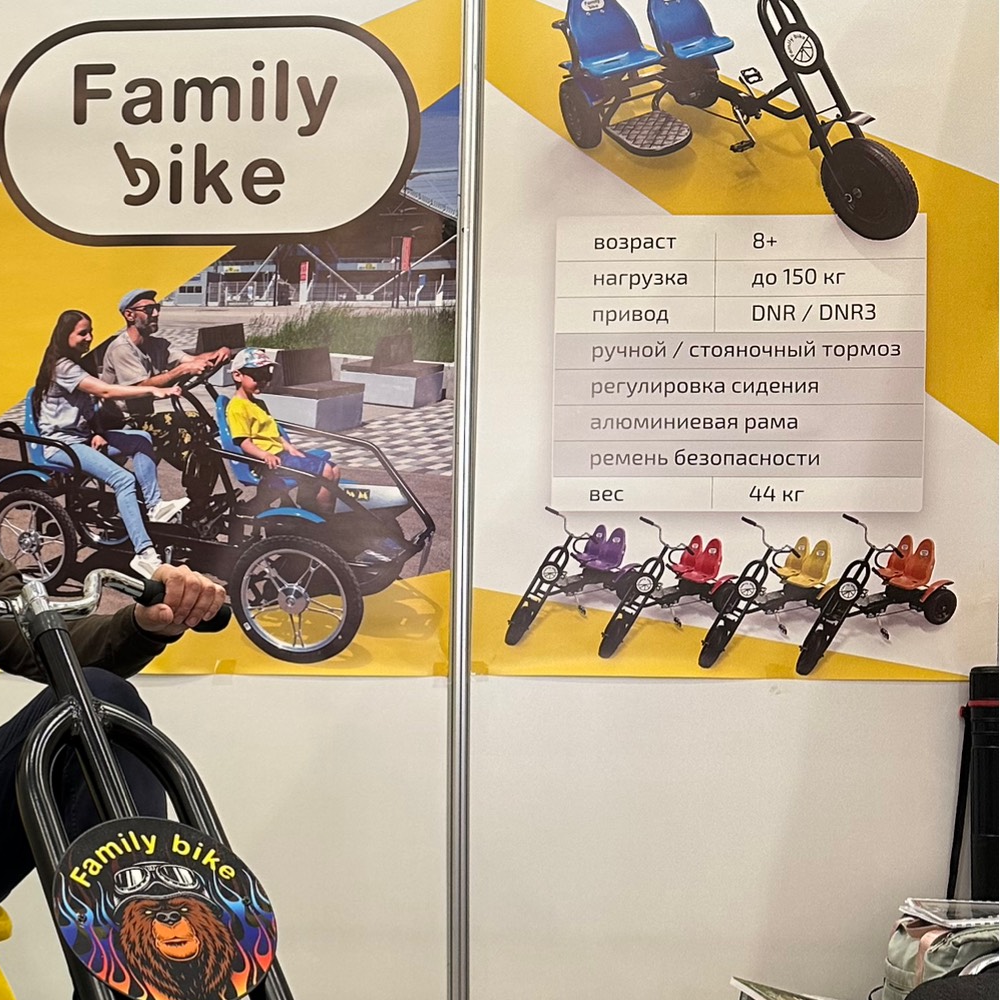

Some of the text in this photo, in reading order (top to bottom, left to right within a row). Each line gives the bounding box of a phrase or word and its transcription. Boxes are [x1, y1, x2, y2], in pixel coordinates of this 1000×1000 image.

[74, 60, 338, 137] Family
[114, 142, 285, 206] bike
[593, 232, 777, 254] возраст 8+
[594, 268, 846, 290] нагрузка до 150 кг
[593, 303, 876, 326] привод DNR / DNR3
[593, 341, 900, 362] ручной / стояночный тормоз
[592, 381, 818, 398] регулировка сидения
[591, 417, 797, 434] алюминиевая рама
[590, 449, 819, 470] ремень безопасности
[589, 486, 804, 502] вес 44 кг
[70, 830, 236, 888] Family bike
